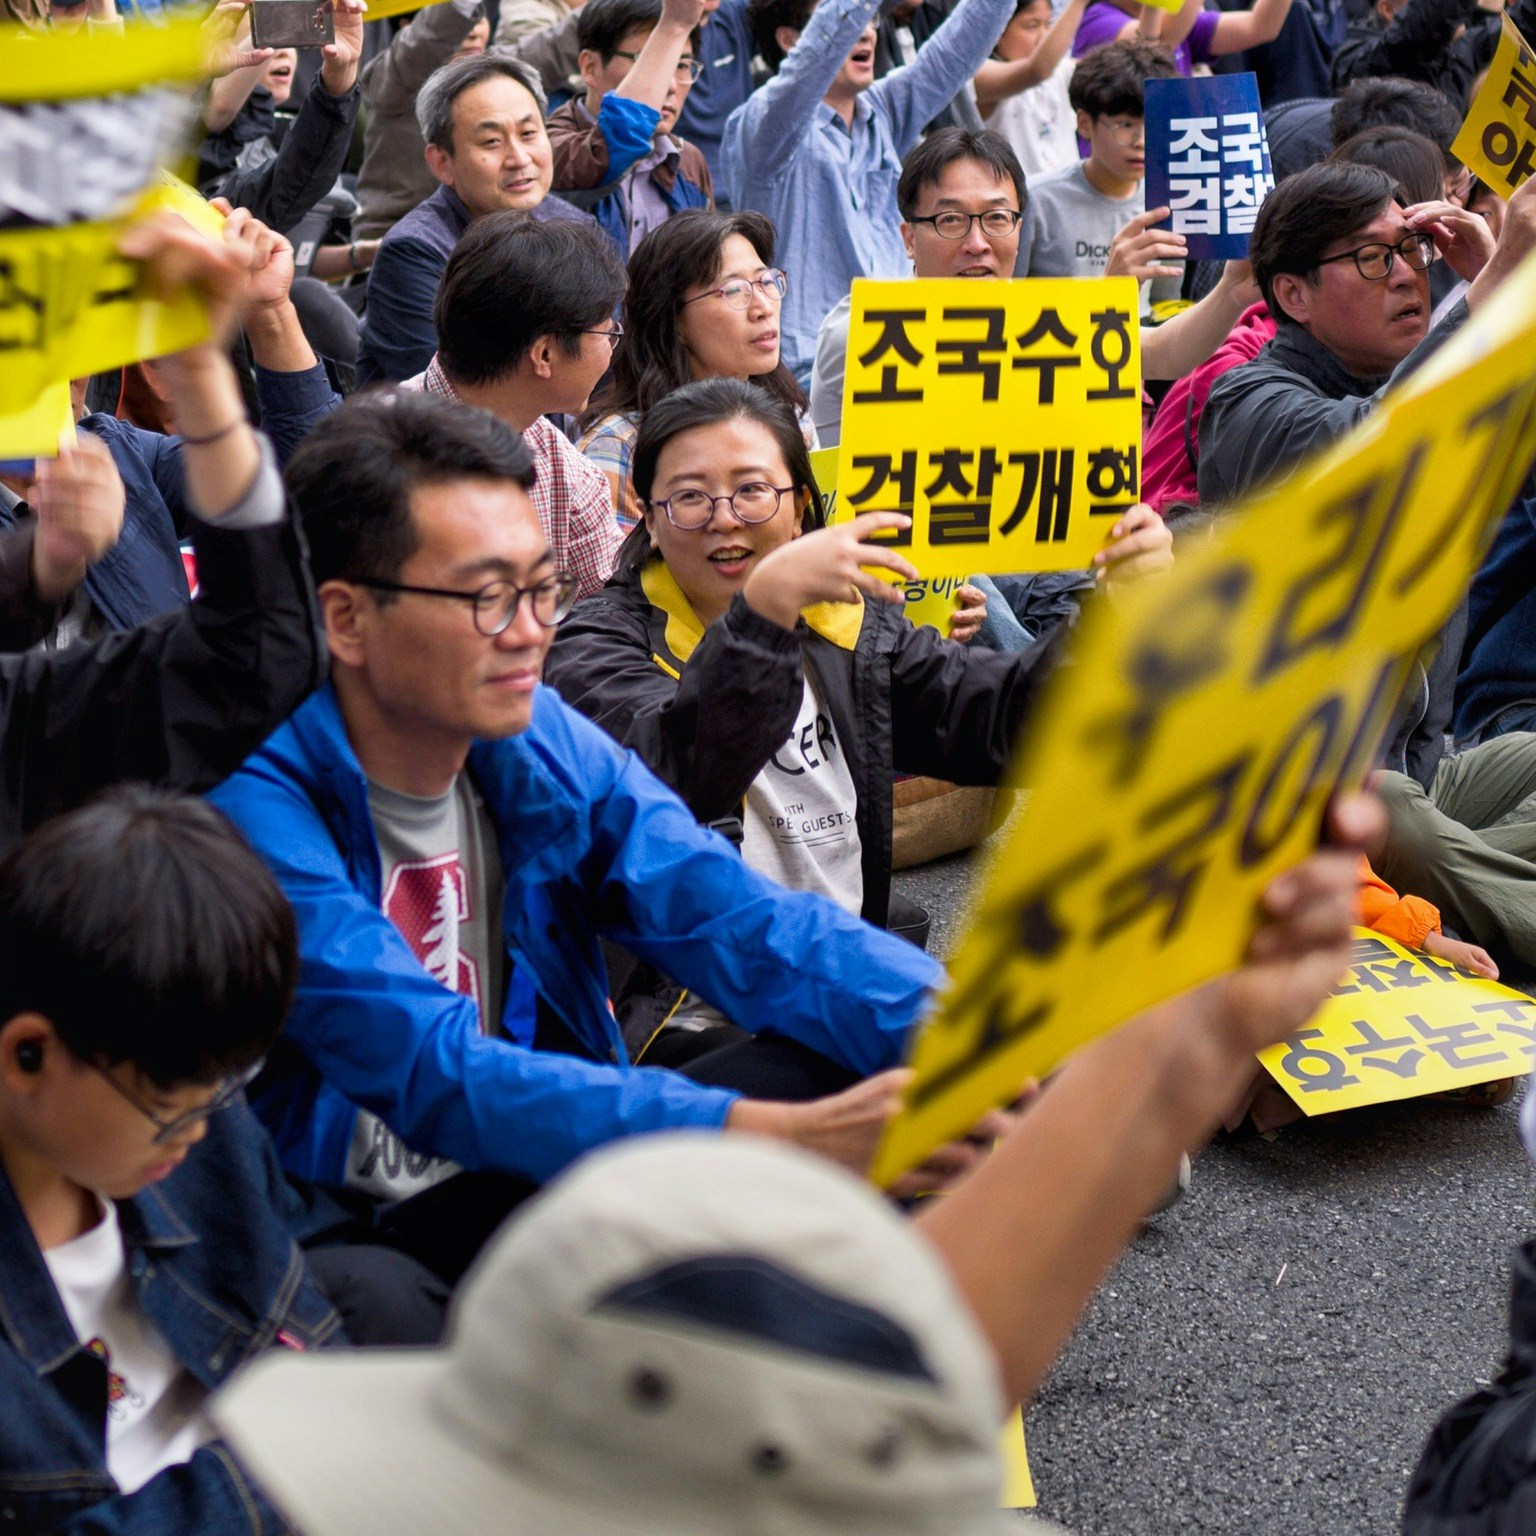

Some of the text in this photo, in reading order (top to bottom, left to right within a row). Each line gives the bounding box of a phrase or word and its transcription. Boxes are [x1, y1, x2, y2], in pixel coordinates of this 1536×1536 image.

[853, 305, 1137, 408] 조국수호
[844, 446, 1138, 551] 검찰개혁
[802, 809, 853, 835] GUESTS
